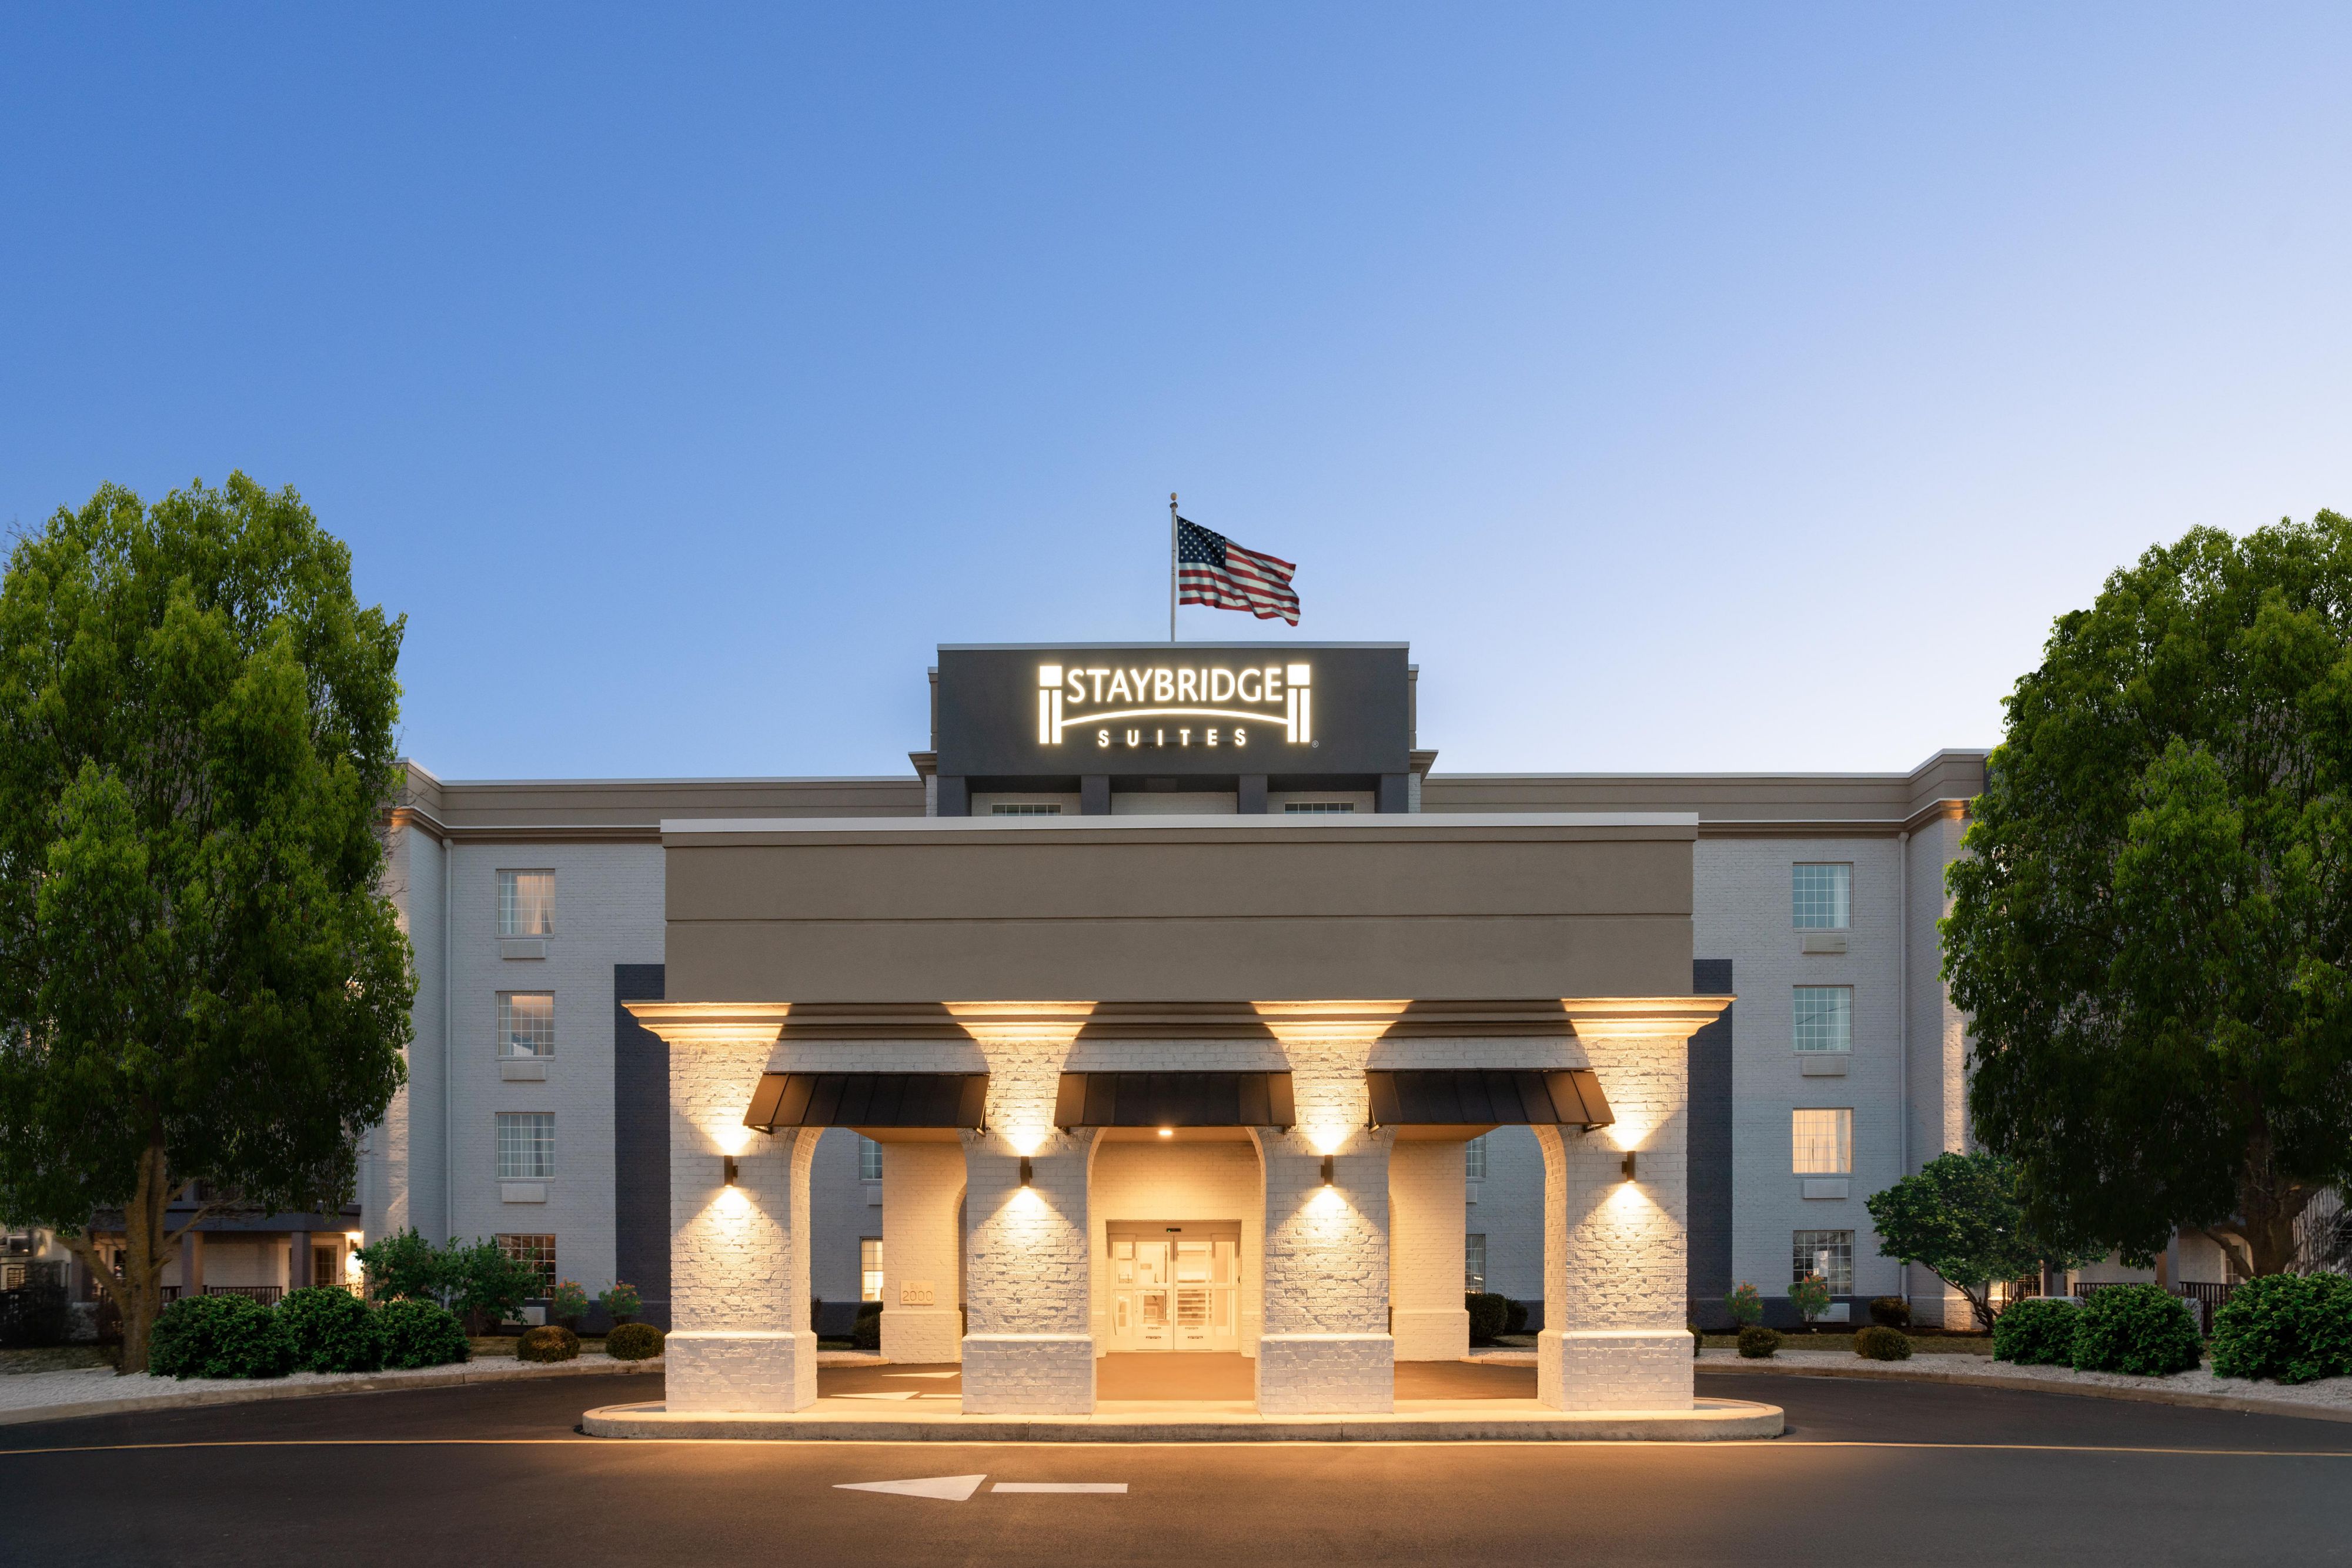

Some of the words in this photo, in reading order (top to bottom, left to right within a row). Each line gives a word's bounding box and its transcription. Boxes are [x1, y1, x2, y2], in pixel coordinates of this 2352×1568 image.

[1067, 667, 1282, 703] STAYBRIDGE
[1098, 729, 1245, 747] SUITES
[903, 1290, 933, 1301] 2000
